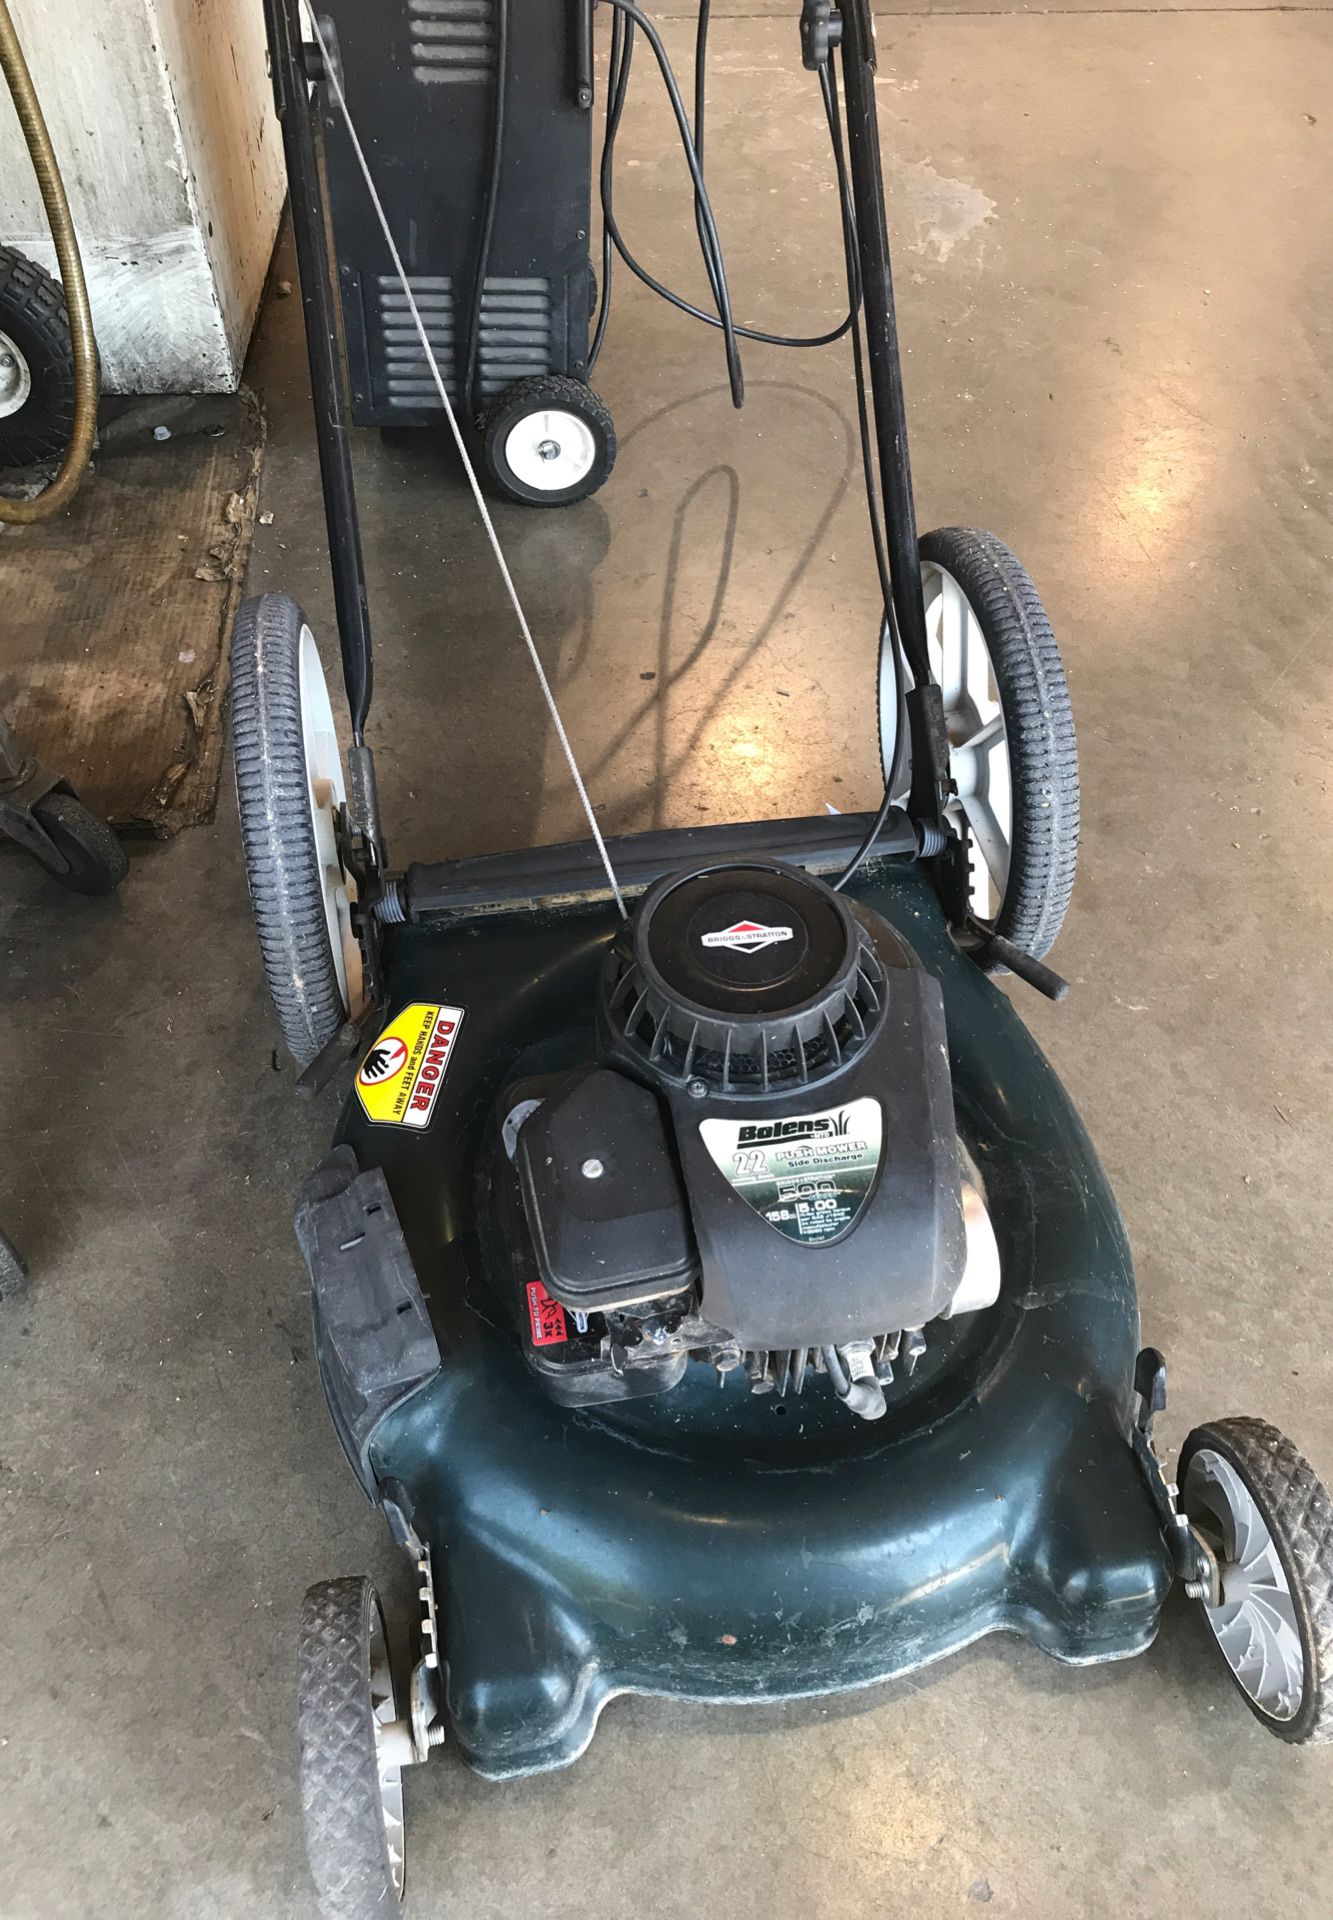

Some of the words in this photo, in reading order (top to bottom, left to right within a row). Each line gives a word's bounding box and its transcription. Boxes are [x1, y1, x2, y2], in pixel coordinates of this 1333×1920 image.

[708, 935, 740, 943] BRIGGS
[747, 931, 787, 940] STRATTON
[423, 1011, 435, 1030] KEEP
[414, 1031, 428, 1055] HANDS
[407, 1056, 418, 1070] and
[410, 1020, 456, 1111] DANGER
[401, 1071, 415, 1092] FEET
[392, 1092, 408, 1115] AWAY
[737, 1118, 830, 1142] Bolens
[775, 1147, 815, 1161] PUSH
[815, 1141, 868, 1156] MOWER
[788, 1159, 810, 1168] Side
[813, 1153, 863, 1165] Discharge
[732, 1150, 769, 1177] 22
[777, 1180, 837, 1202] 500
[799, 1199, 837, 1212] 5.00
[530, 1287, 538, 1306] PUSH
[533, 1306, 539, 1317] TO
[534, 1317, 543, 1340] PRIME
